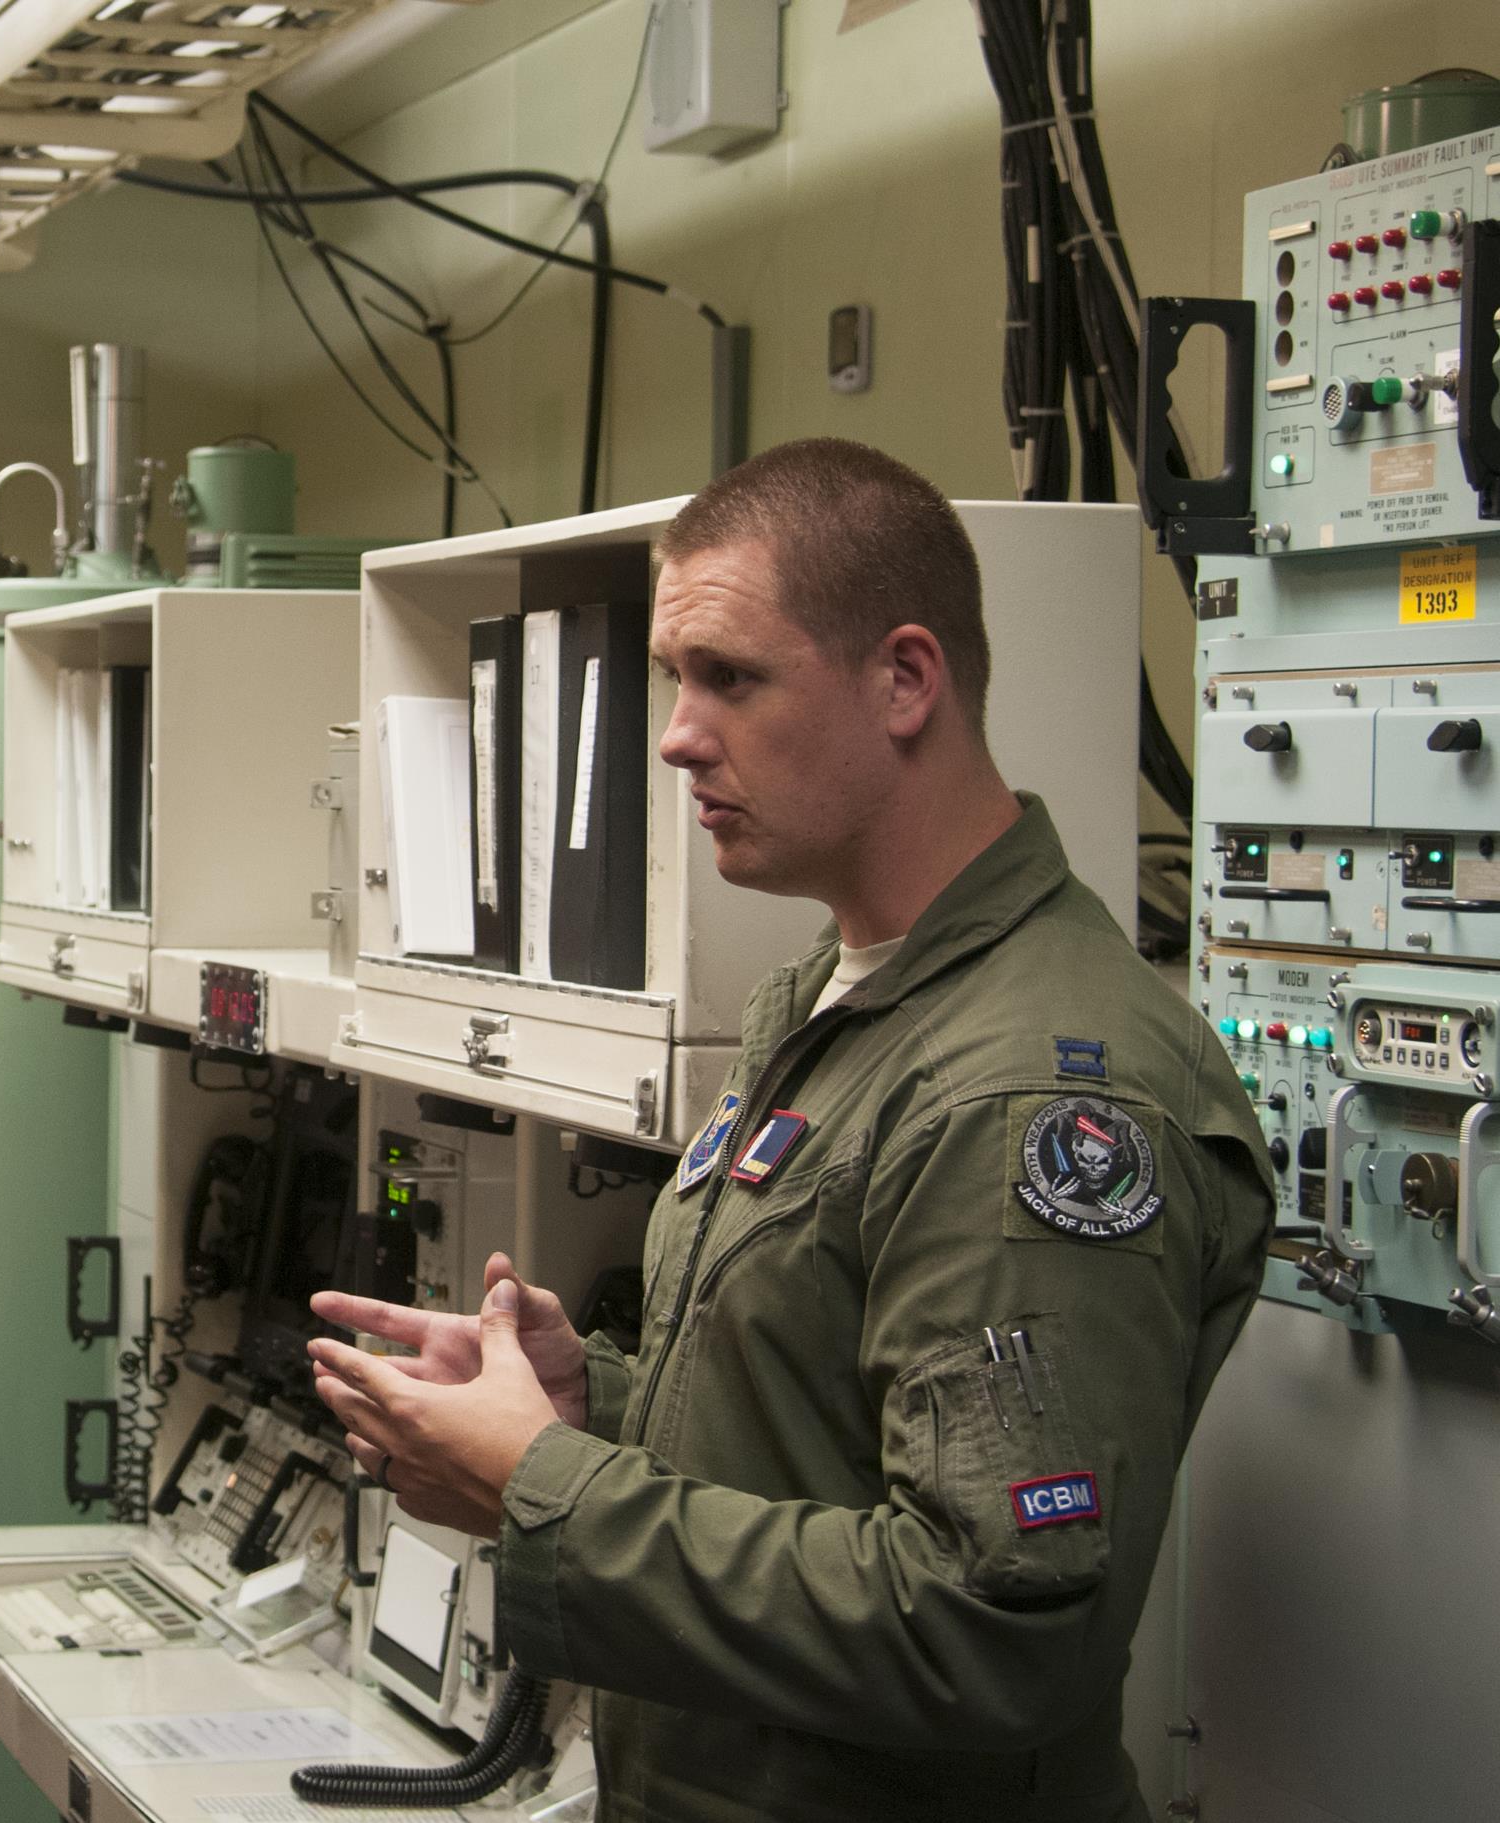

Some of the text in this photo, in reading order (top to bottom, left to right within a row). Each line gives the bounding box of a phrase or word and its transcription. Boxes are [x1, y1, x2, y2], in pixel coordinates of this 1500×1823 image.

[1380, 151, 1429, 178] SUMMARY
[1434, 141, 1466, 165] FAULT
[1470, 133, 1495, 155] UNIT
[1389, 329, 1407, 340] ALARM
[1366, 492, 1450, 510] POWER OFF PRIOR TO REMOVAL
[1373, 511, 1381, 522] OR
[1382, 509, 1409, 521] INSERTION
[1411, 507, 1419, 518] OF
[1420, 505, 1443, 517] DRAWER
[1382, 523, 1394, 533] TWO
[1396, 520, 1417, 532] PERSON
[1413, 553, 1463, 569] UNIT REF
[1403, 570, 1473, 588] DESIGNATION
[1208, 581, 1228, 598] UNIT
[1415, 588, 1458, 615] 1393
[1235, 869, 1255, 879] POWER
[1416, 877, 1438, 887] POWER
[1278, 969, 1309, 988] MODEM
[1027, 1101, 1152, 1186] 90TH WEAPONS & TACTICS
[1018, 1185, 1160, 1236] JACK OF ALL TRADES
[1023, 1483, 1091, 1516] ICBM
